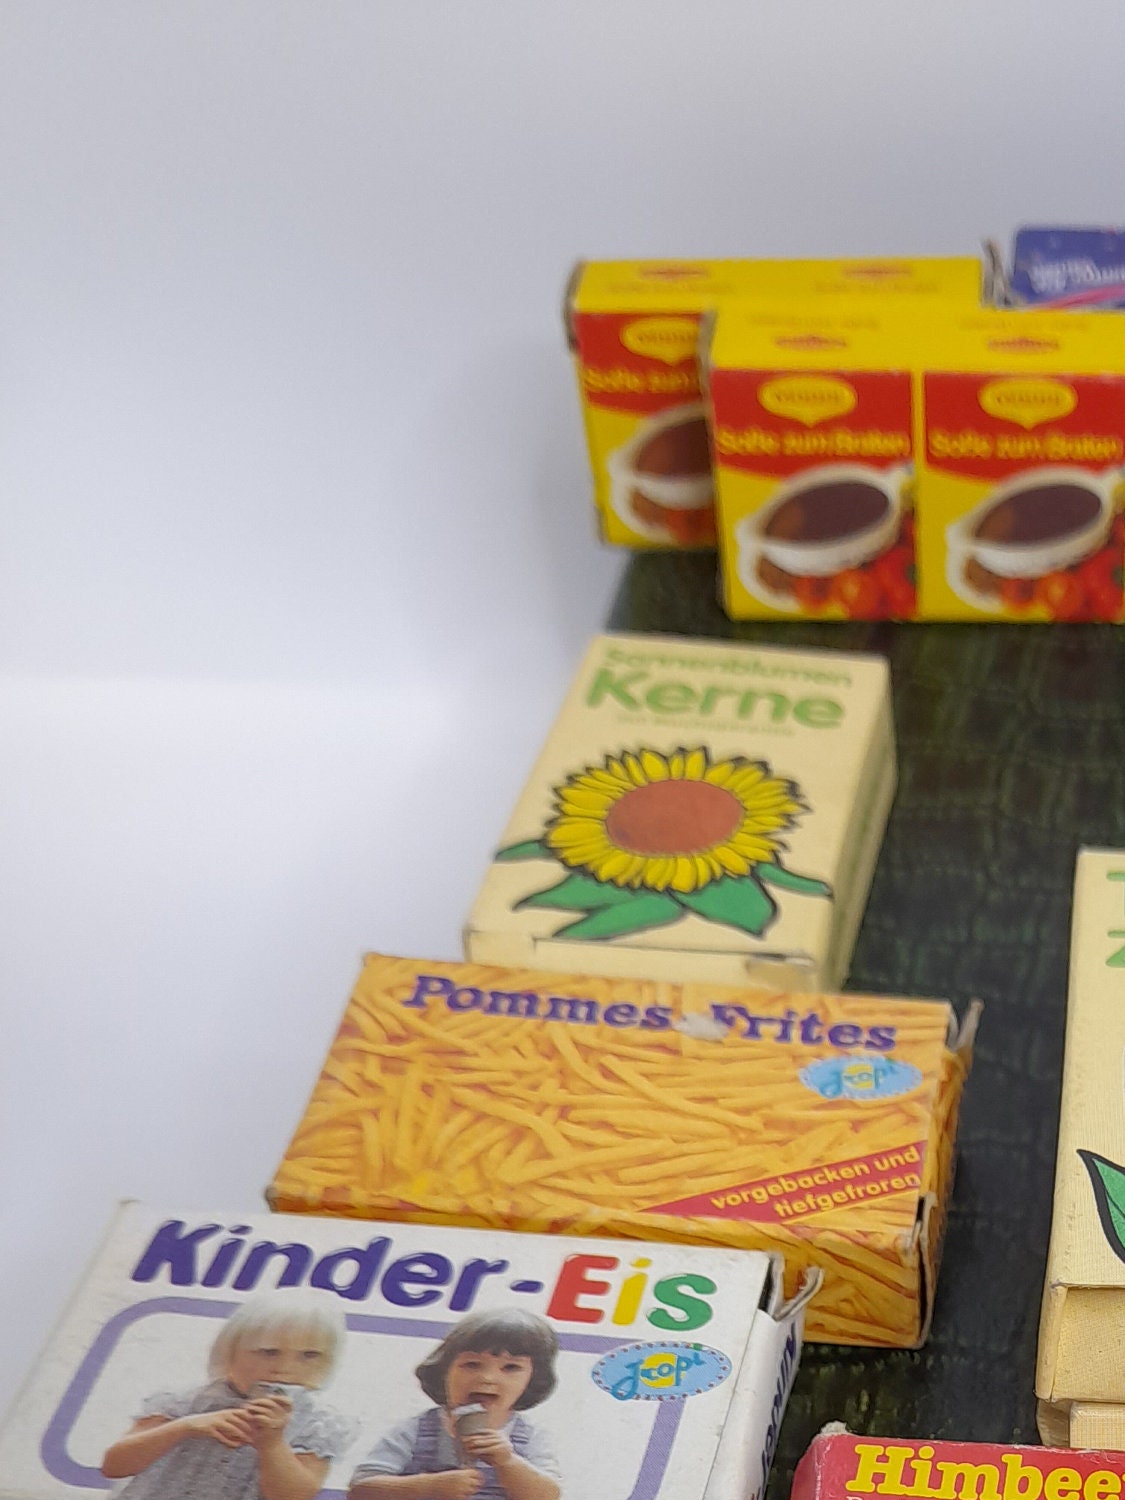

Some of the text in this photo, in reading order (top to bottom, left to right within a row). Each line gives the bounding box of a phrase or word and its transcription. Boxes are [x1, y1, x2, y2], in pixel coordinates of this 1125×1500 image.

[587, 667, 845, 730] Kerne
[401, 974, 673, 1030] Pommes
[711, 1146, 920, 1209] vorgebacken und
[773, 1173, 921, 1217] tiefgefroren
[131, 1218, 719, 1332] Kinder-Eis
